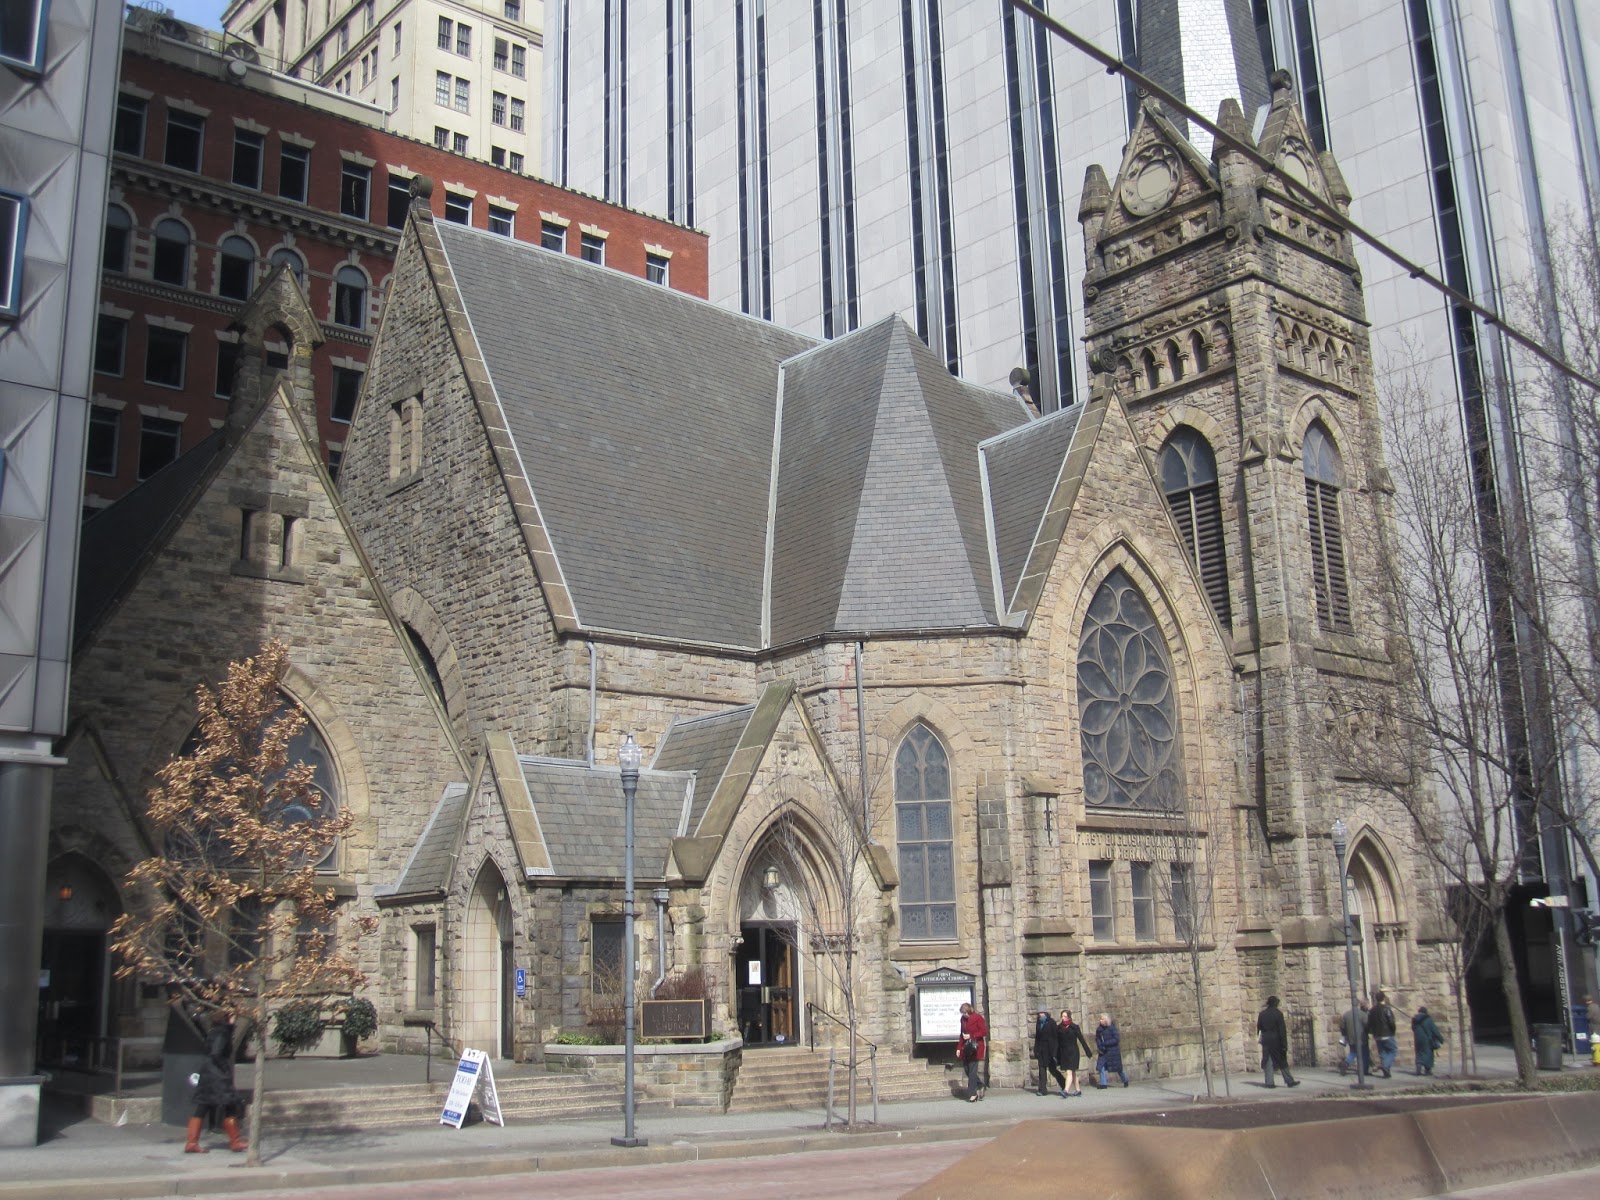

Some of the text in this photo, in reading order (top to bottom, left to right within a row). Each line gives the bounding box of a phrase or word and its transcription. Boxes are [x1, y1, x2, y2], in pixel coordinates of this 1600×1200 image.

[1075, 833, 1102, 846] FIRST
[1105, 834, 1141, 847] ENGLISH
[1100, 848, 1146, 861] LUTHERAN
